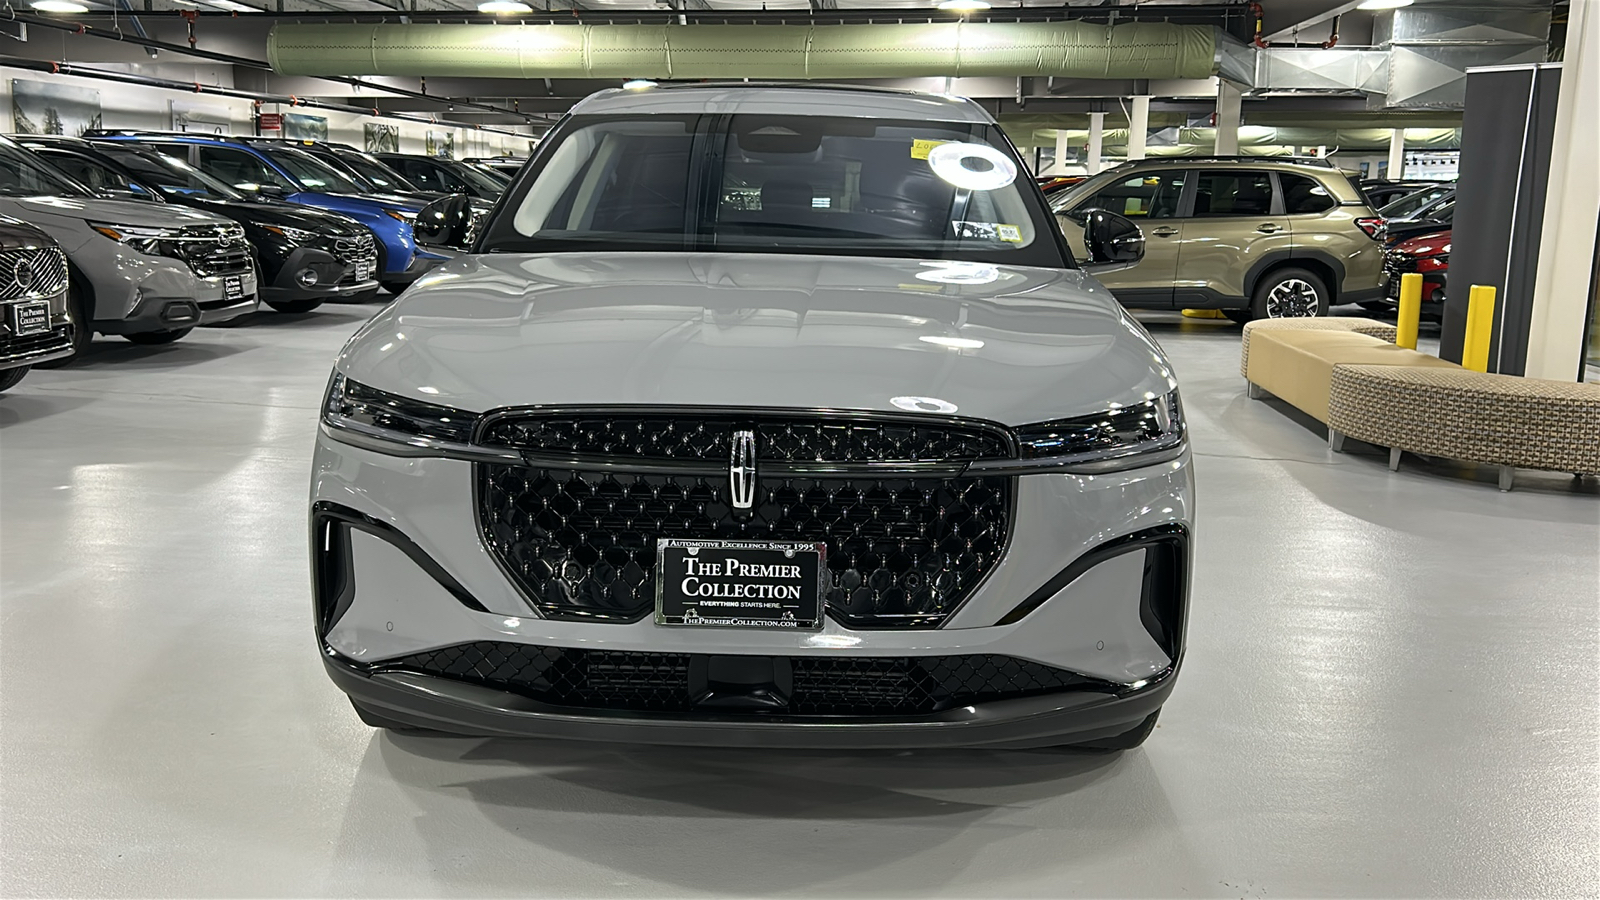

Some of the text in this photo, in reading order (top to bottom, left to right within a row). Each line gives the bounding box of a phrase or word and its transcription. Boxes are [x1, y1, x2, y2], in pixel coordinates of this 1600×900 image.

[670, 539, 814, 551] AUTOMOTIVE EXCELLENCE SINCE 1995
[682, 557, 802, 579] THE PREMIER
[681, 577, 802, 600] COLLECTION
